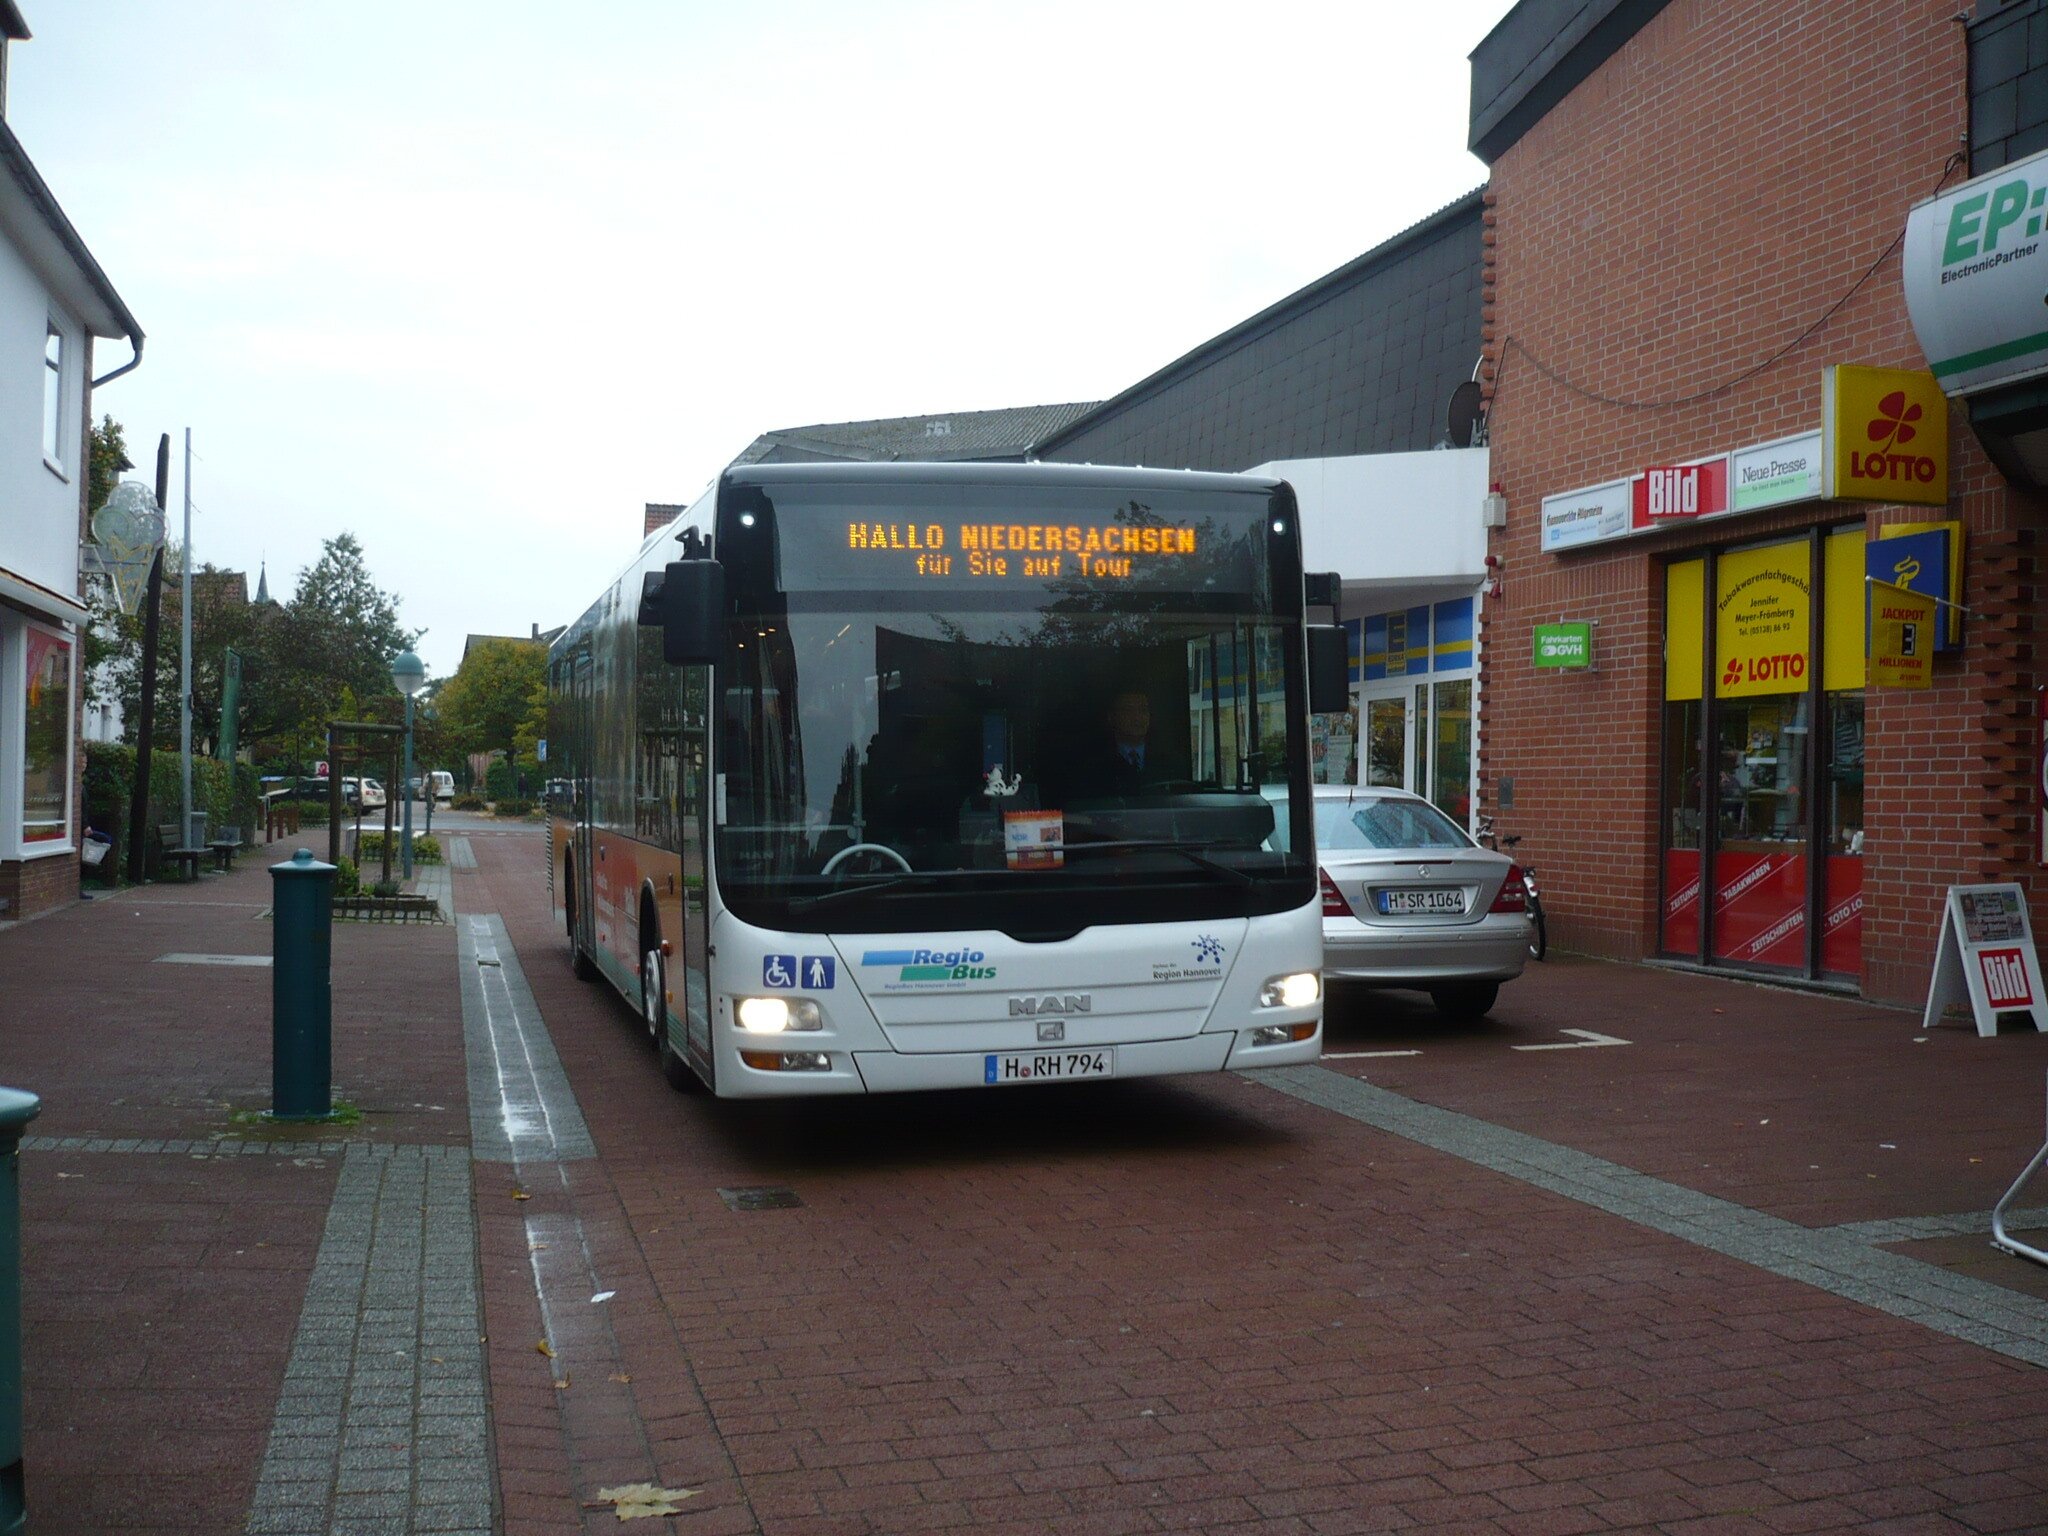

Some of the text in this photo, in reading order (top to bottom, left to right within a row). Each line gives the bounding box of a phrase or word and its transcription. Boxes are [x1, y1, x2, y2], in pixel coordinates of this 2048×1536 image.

[1941, 243, 2038, 284] ElectronicPartner
[1742, 457, 1806, 484] Neue Presse
[1851, 451, 1936, 483] LOTTO
[1648, 468, 1698, 514] Bild
[849, 522, 1196, 554] HALLO NIEDERSACHSEN
[916, 552, 1132, 578] für Sie auf Tour
[1750, 595, 1779, 608] Jennifer
[1882, 607, 1925, 620] JACKPOT
[1541, 635, 1582, 644] Fahrkarten
[1557, 644, 1582, 655] GVH
[1904, 624, 1915, 654] 3
[1748, 653, 1805, 682] LOTTO
[1879, 657, 1922, 669] MILLIONEN
[1722, 861, 1770, 900] TABAKWAREN
[1389, 892, 1463, 908] H SR 1064
[1828, 906, 1850, 926] TOTO
[1751, 912, 1804, 953] ZEITSCHRIFTEN
[913, 948, 985, 968] Regio
[951, 964, 997, 979] Bus
[1153, 967, 1221, 980] Region Hannover
[1982, 955, 2028, 1000] Bild
[1009, 994, 1091, 1016] MAN
[1005, 1058, 1018, 1077] H
[1034, 1055, 1060, 1076] RH
[1067, 1053, 1104, 1074] 794
